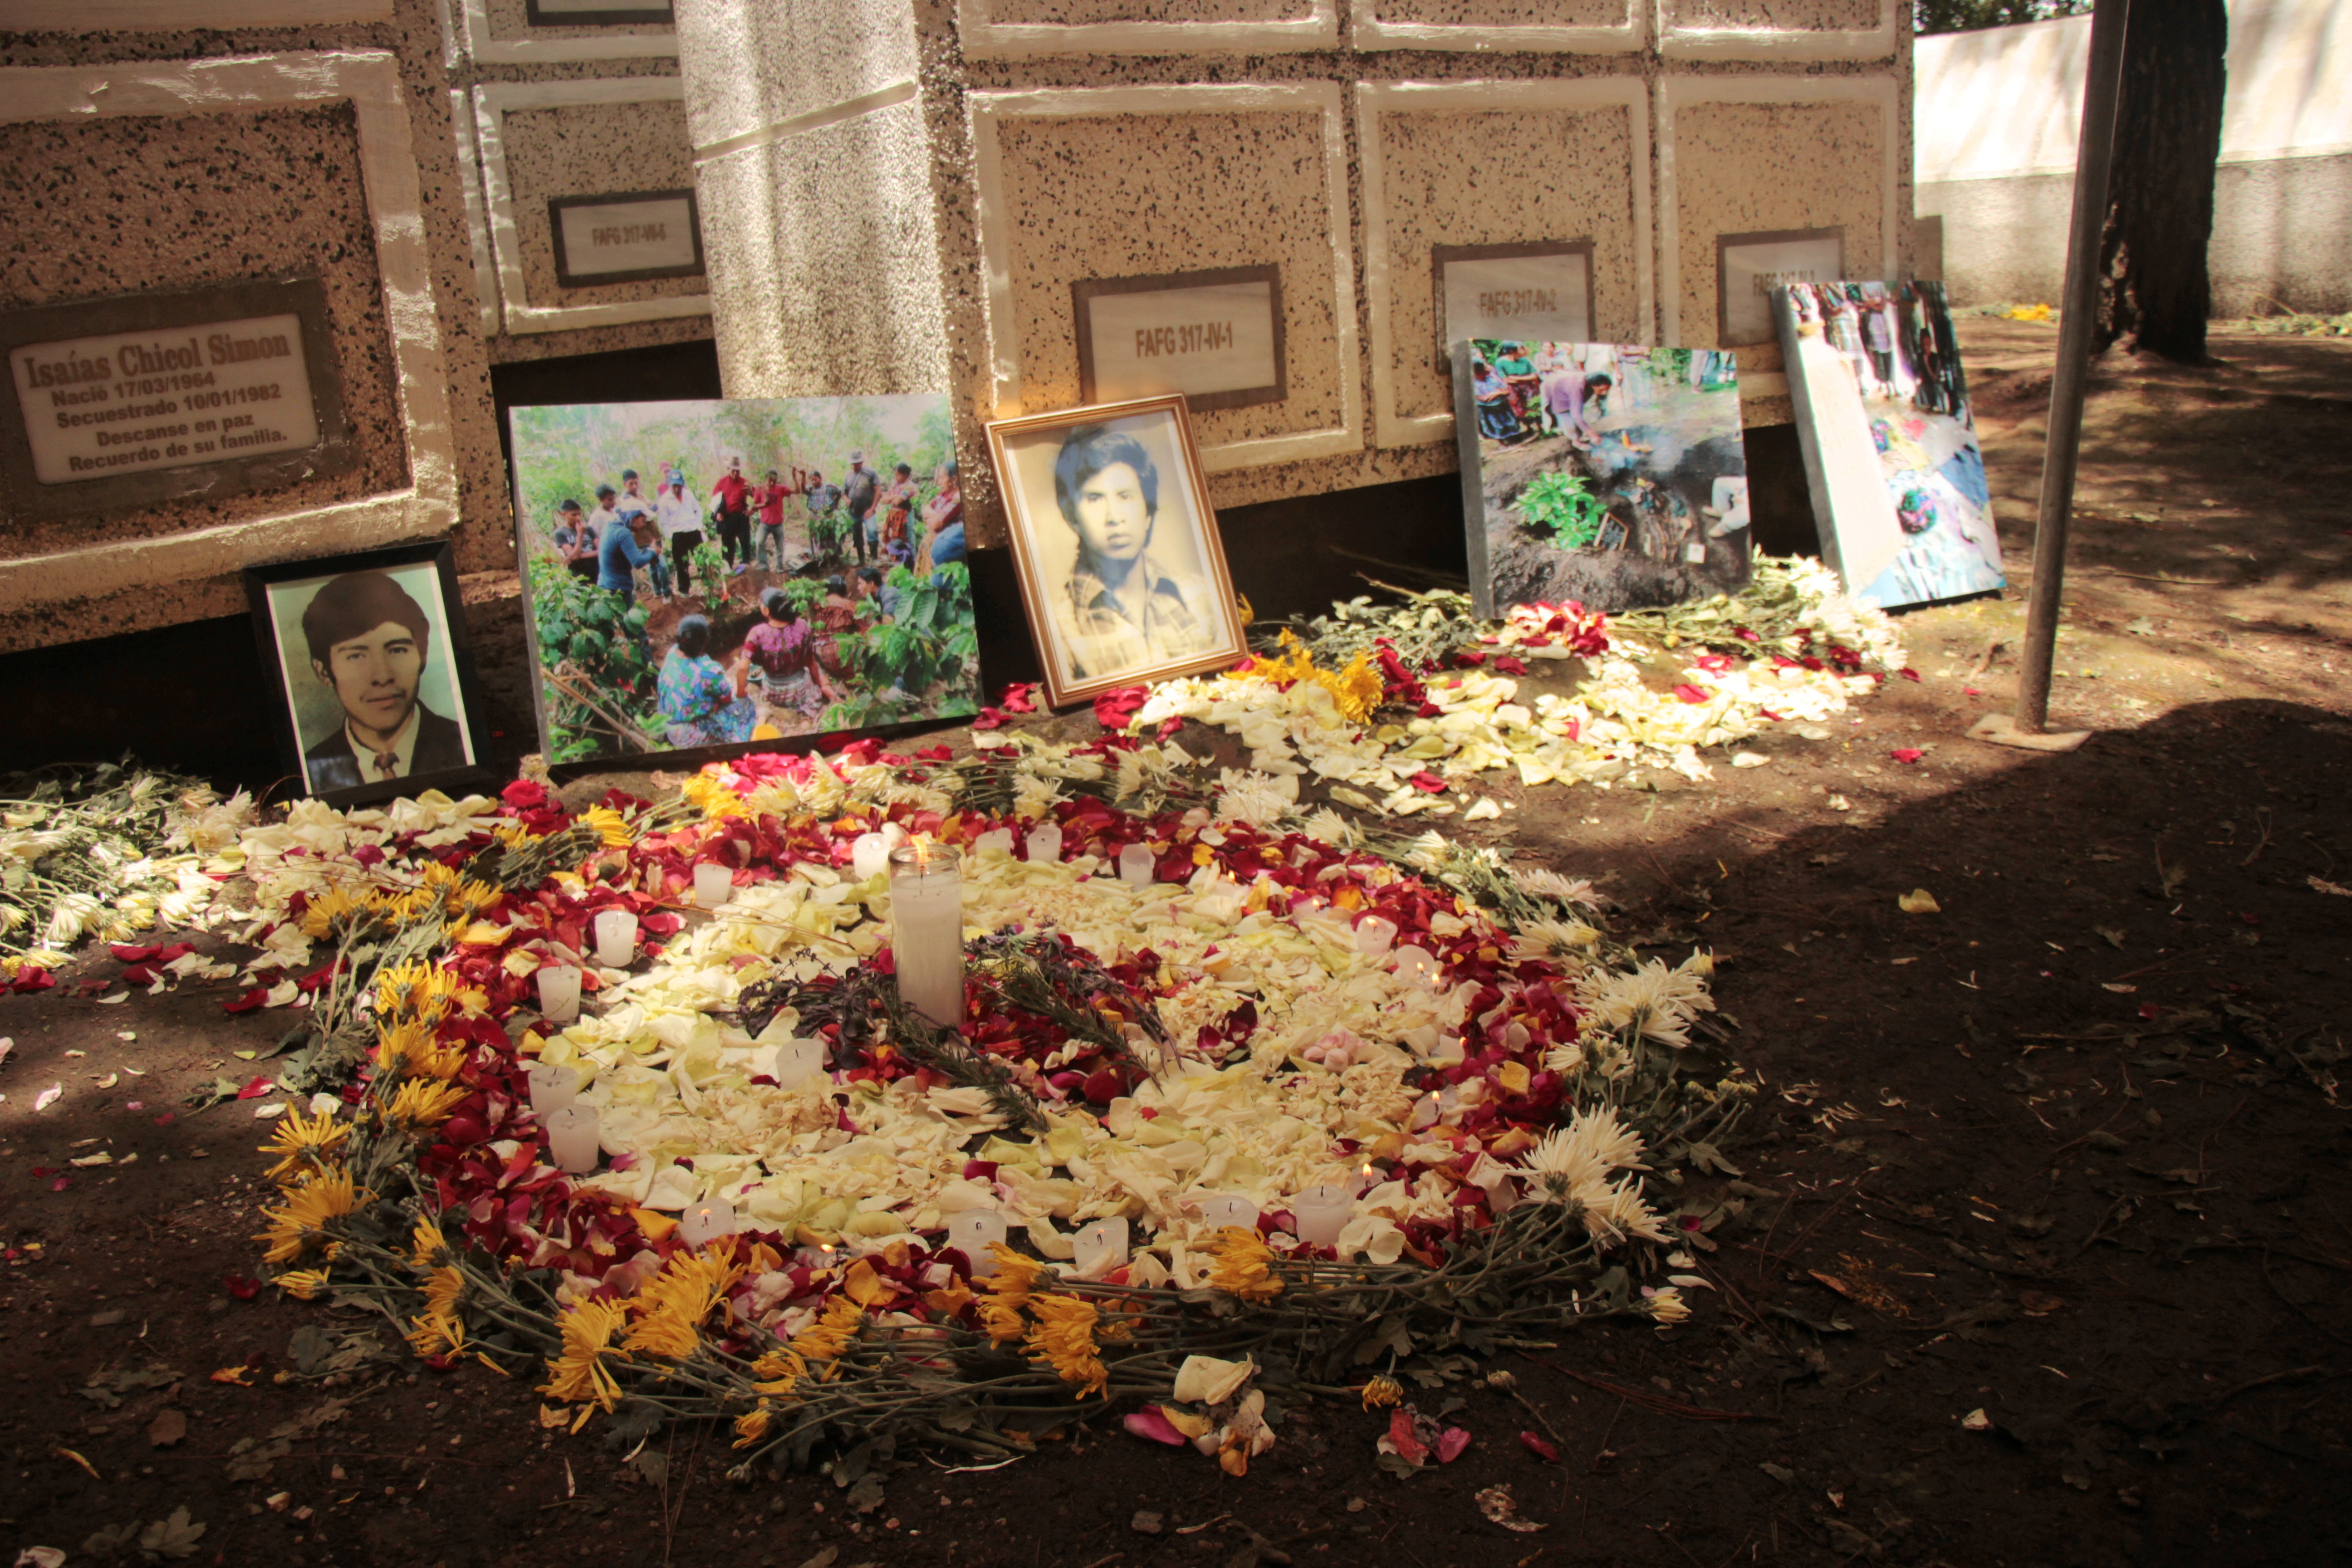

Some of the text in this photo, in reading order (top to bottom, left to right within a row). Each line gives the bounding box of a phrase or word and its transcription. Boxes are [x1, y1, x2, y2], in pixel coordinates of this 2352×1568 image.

[592, 227, 620, 246] FAFG
[1753, 273, 1778, 295] FAFG
[1480, 289, 1557, 318] FAFG 317-IV-2
[1135, 320, 1233, 358] FAFG 317-IV-1
[23, 333, 291, 388] Isaías Chicol Simon
[51, 371, 216, 407] Nació 17/03/1964
[56, 383, 282, 428] Secuestrado 10/01/1982
[96, 414, 254, 447] Descanse en paz
[69, 429, 288, 472] Recuerdo de su familia.
